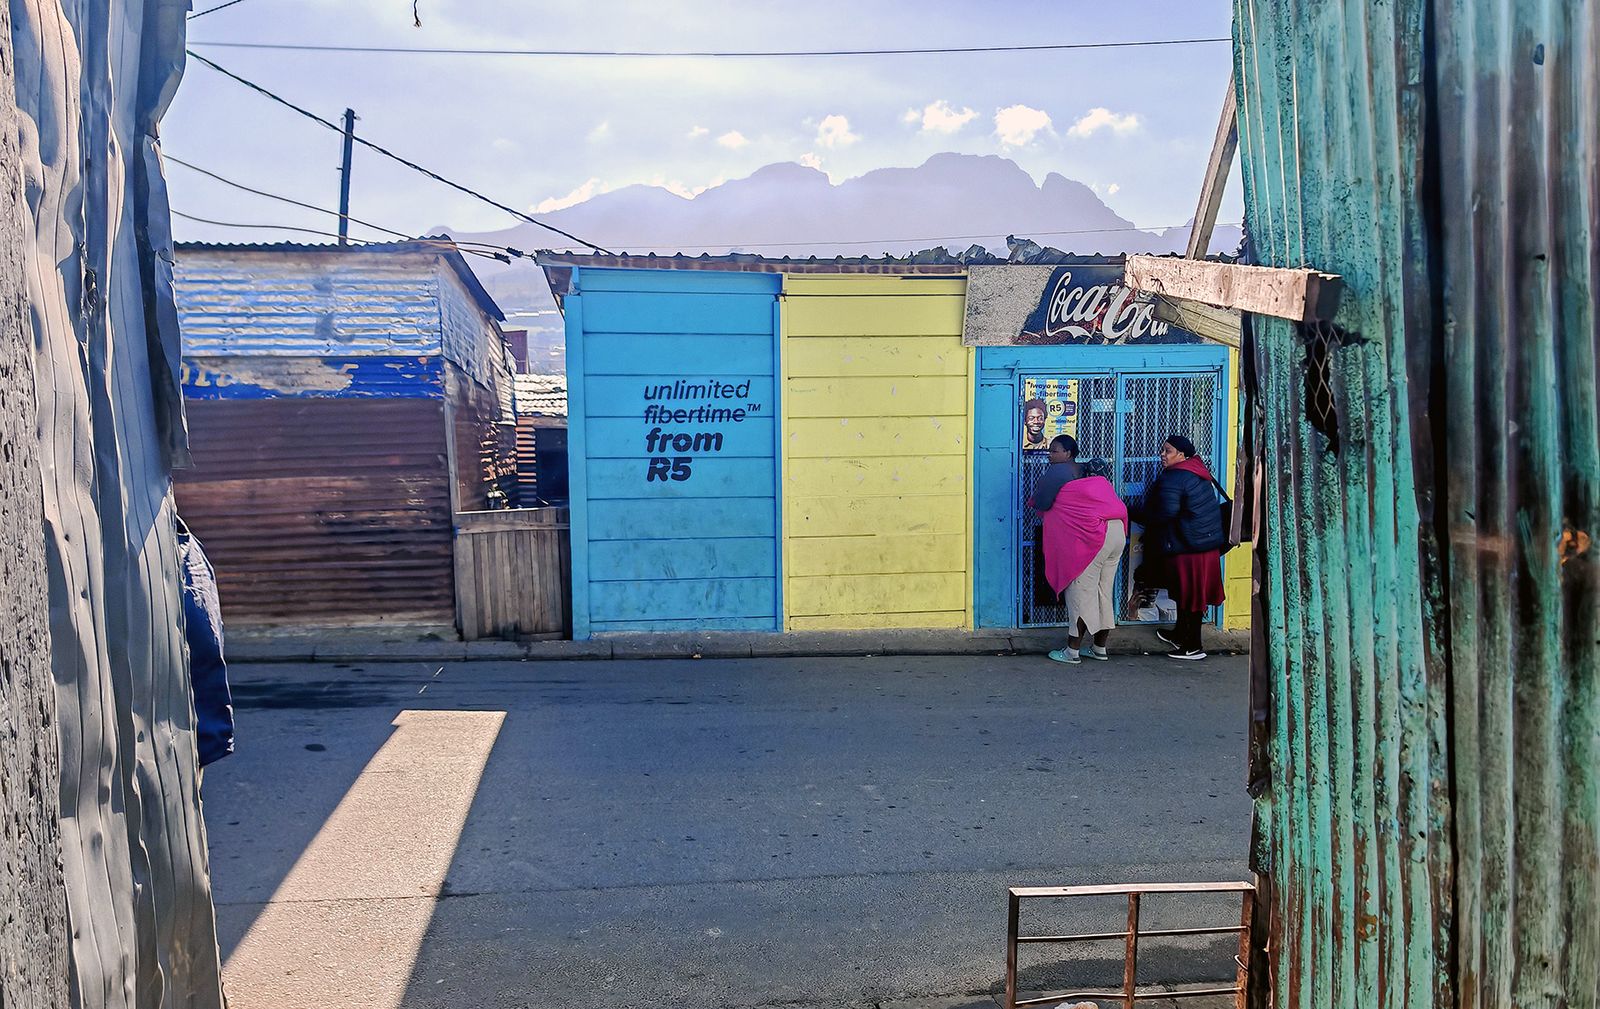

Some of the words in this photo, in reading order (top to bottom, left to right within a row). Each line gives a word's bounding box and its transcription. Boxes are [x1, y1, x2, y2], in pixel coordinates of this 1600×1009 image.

[1045, 272, 1169, 340] Coca-Co
[643, 379, 751, 400] unlimited
[1050, 404, 1062, 412] R5
[645, 427, 724, 453] from
[646, 456, 693, 482] R5
